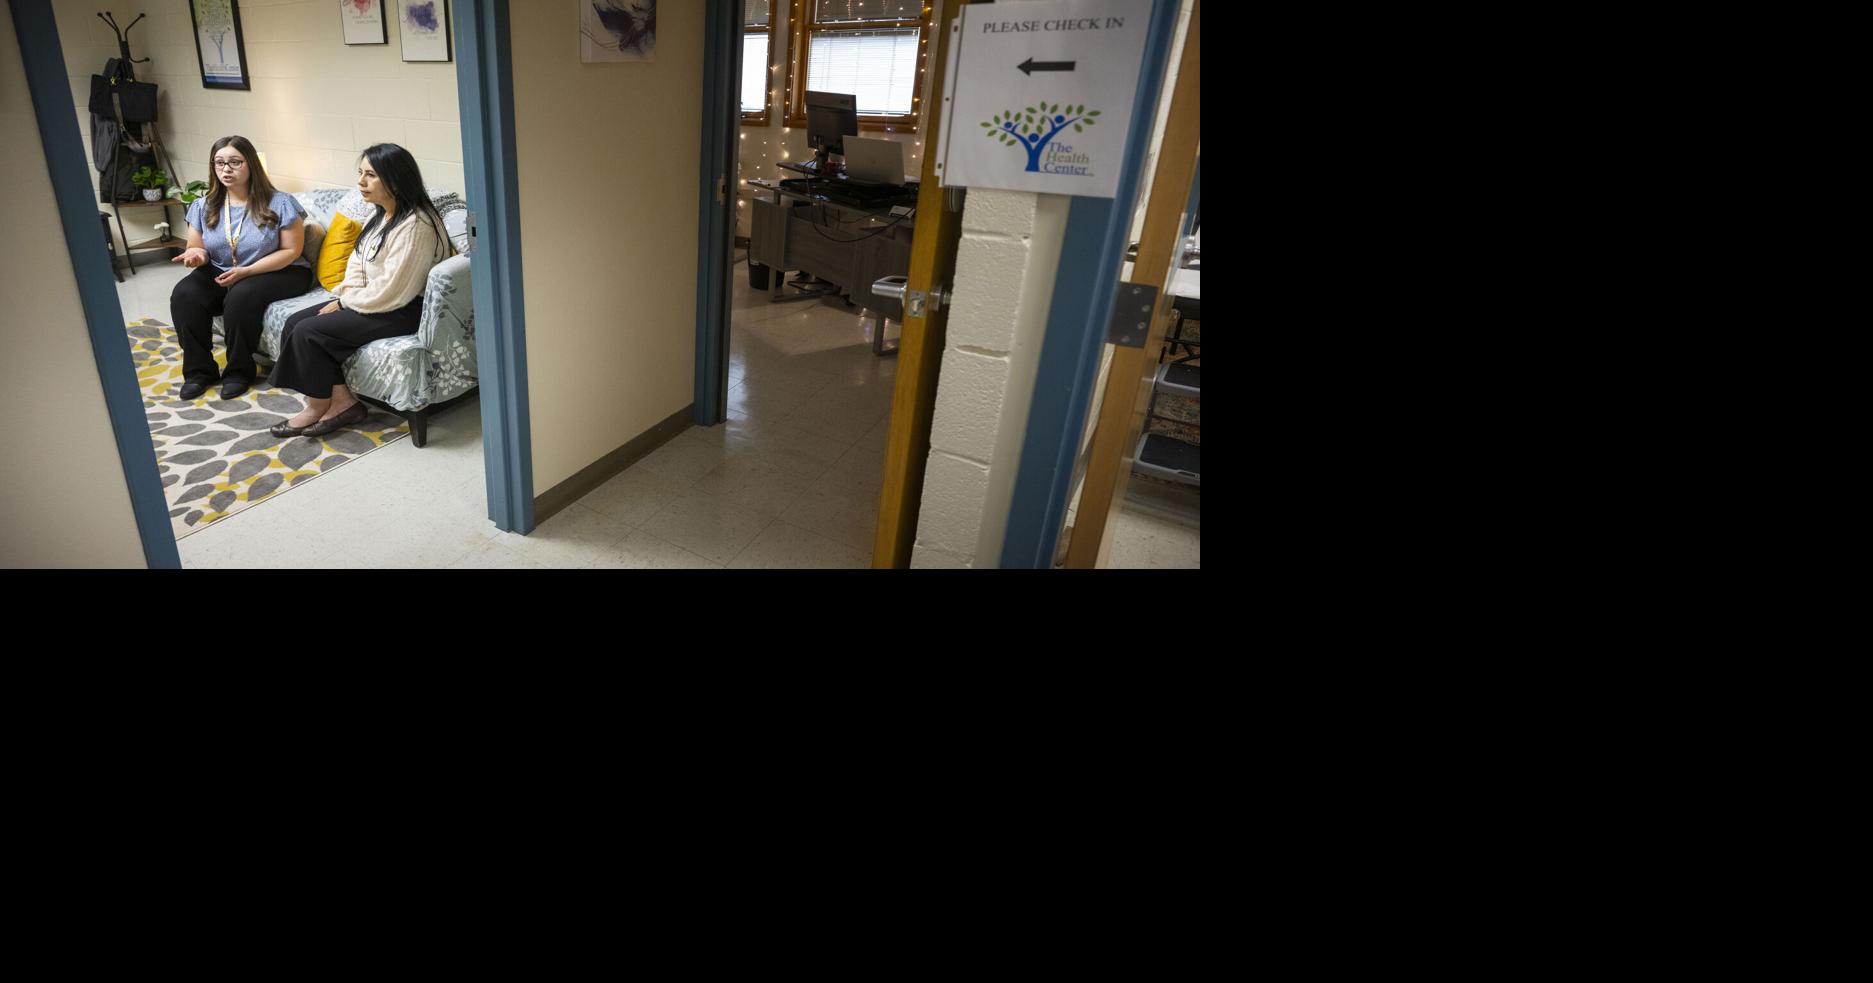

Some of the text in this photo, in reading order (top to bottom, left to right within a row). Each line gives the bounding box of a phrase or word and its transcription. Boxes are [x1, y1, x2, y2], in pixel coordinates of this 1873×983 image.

[982, 16, 1125, 33] PLEASE CHECK IN
[1049, 141, 1073, 153] The
[1046, 152, 1090, 164] Health
[1043, 163, 1089, 176] Center
